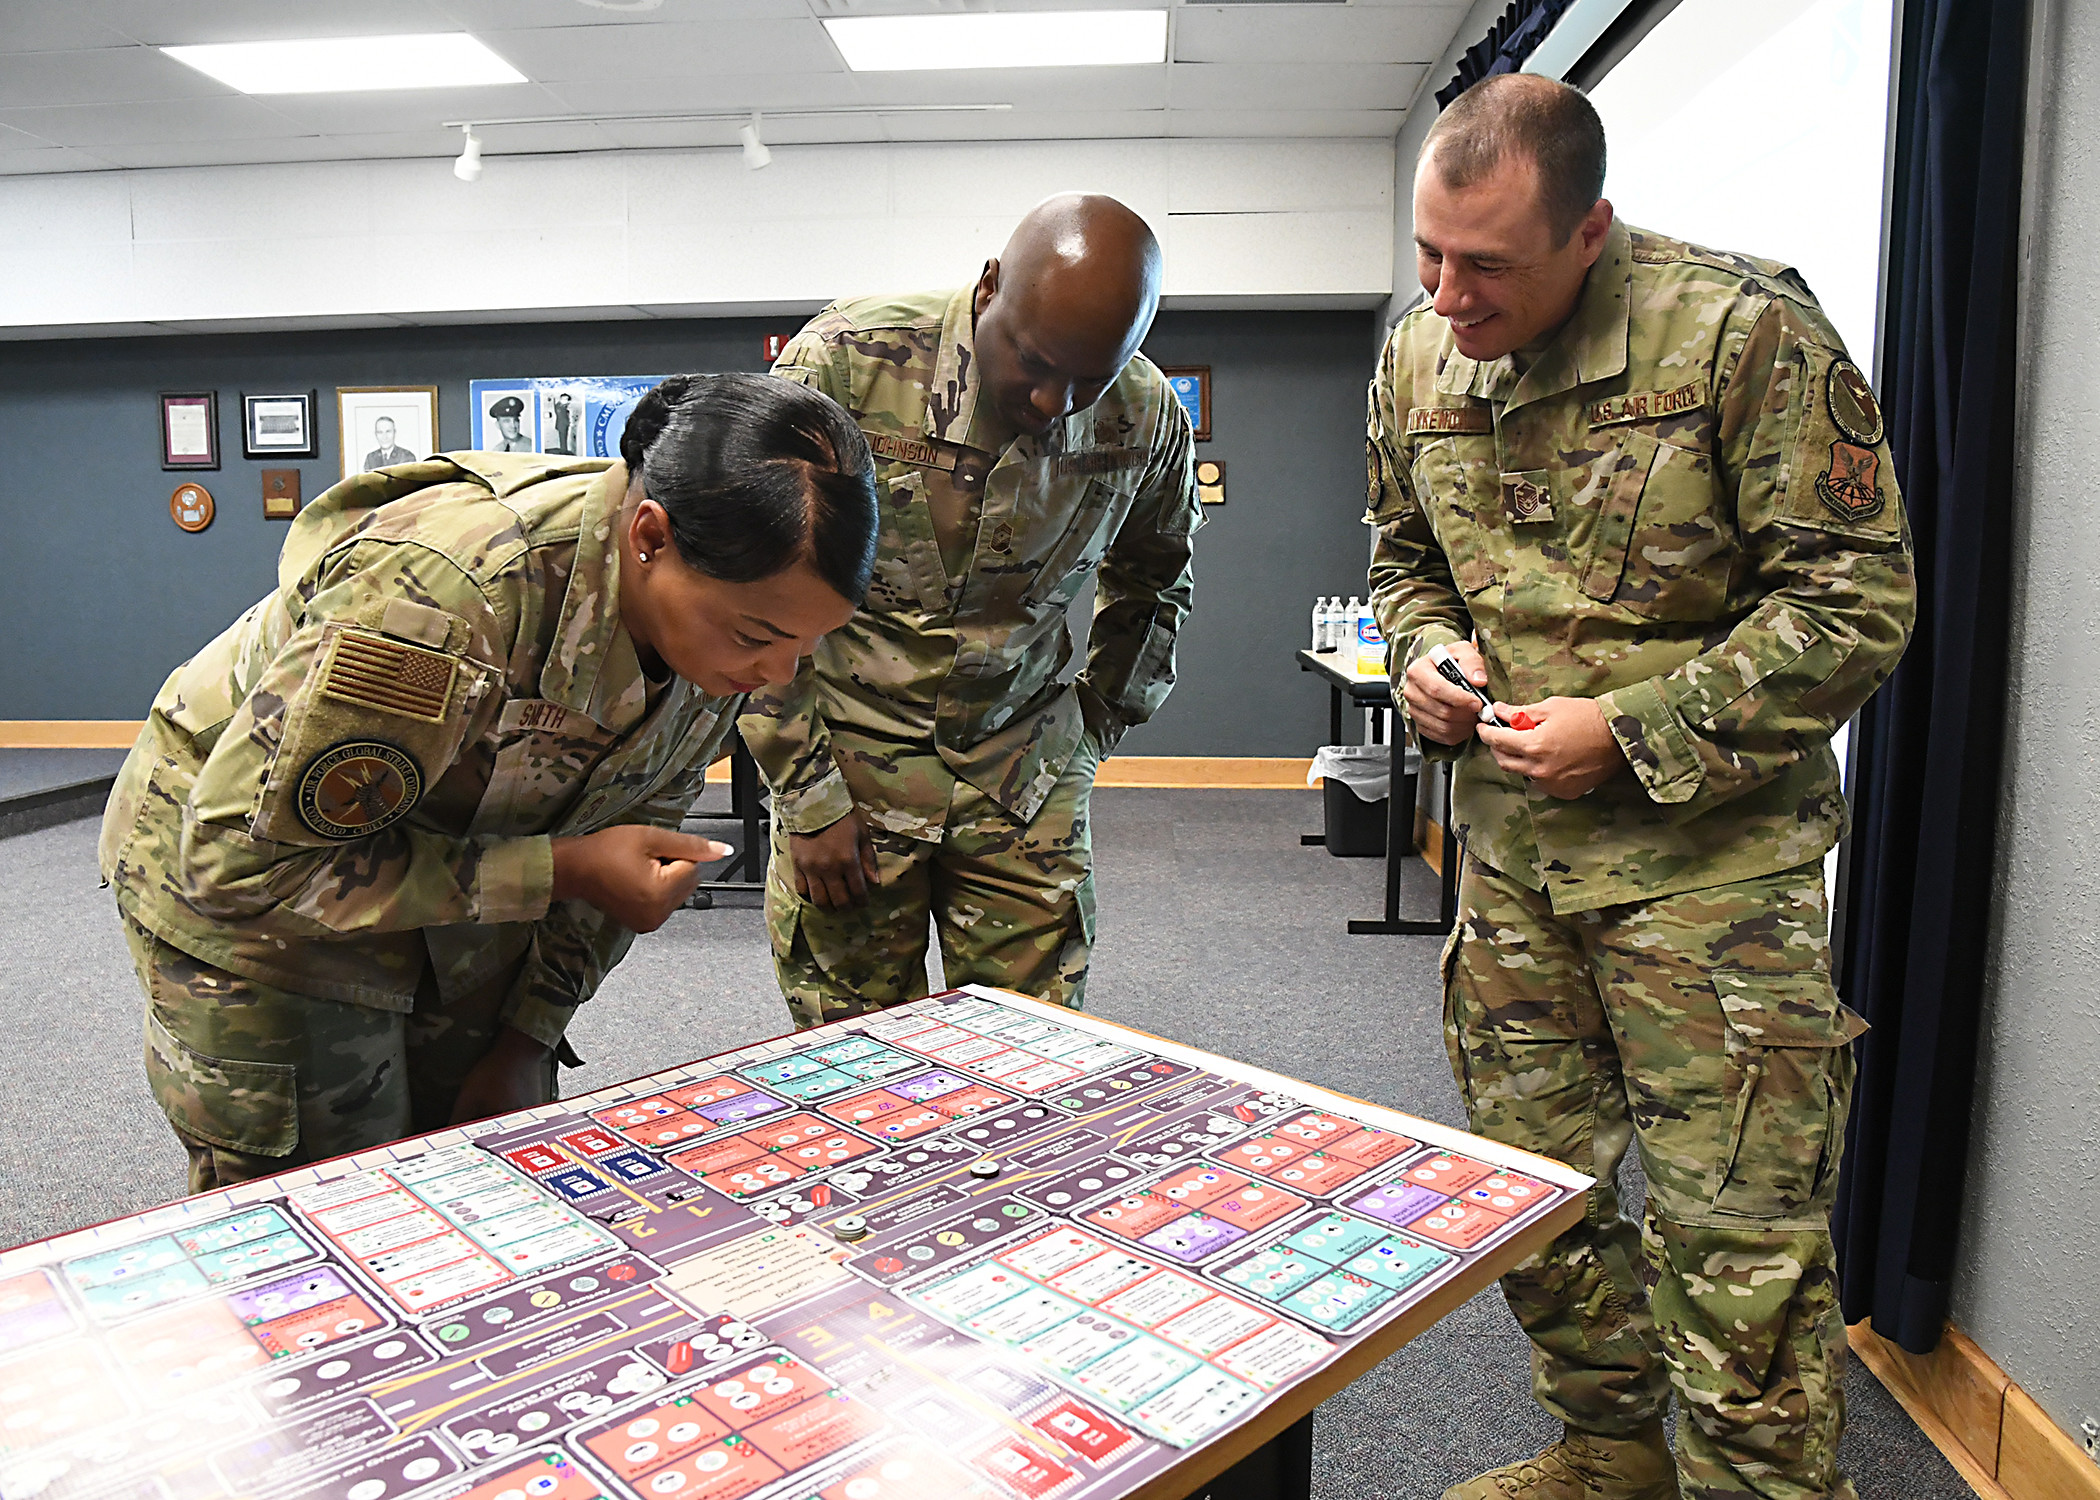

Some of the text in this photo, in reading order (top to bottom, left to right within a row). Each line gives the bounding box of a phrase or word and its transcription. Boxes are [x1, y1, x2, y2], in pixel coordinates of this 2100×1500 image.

[1589, 385, 1698, 423] U.S. AIR FORCE
[871, 434, 939, 465] JOHNSON
[519, 703, 568, 729] SMITH
[305, 778, 318, 795] AIR
[316, 753, 342, 776] FORCE
[342, 747, 383, 760] GLOBAL
[383, 752, 413, 777] STRIKE
[305, 805, 384, 835] COMMAND CHIEF
[626, 1220, 657, 1238] 2
[868, 1301, 895, 1321] 4
